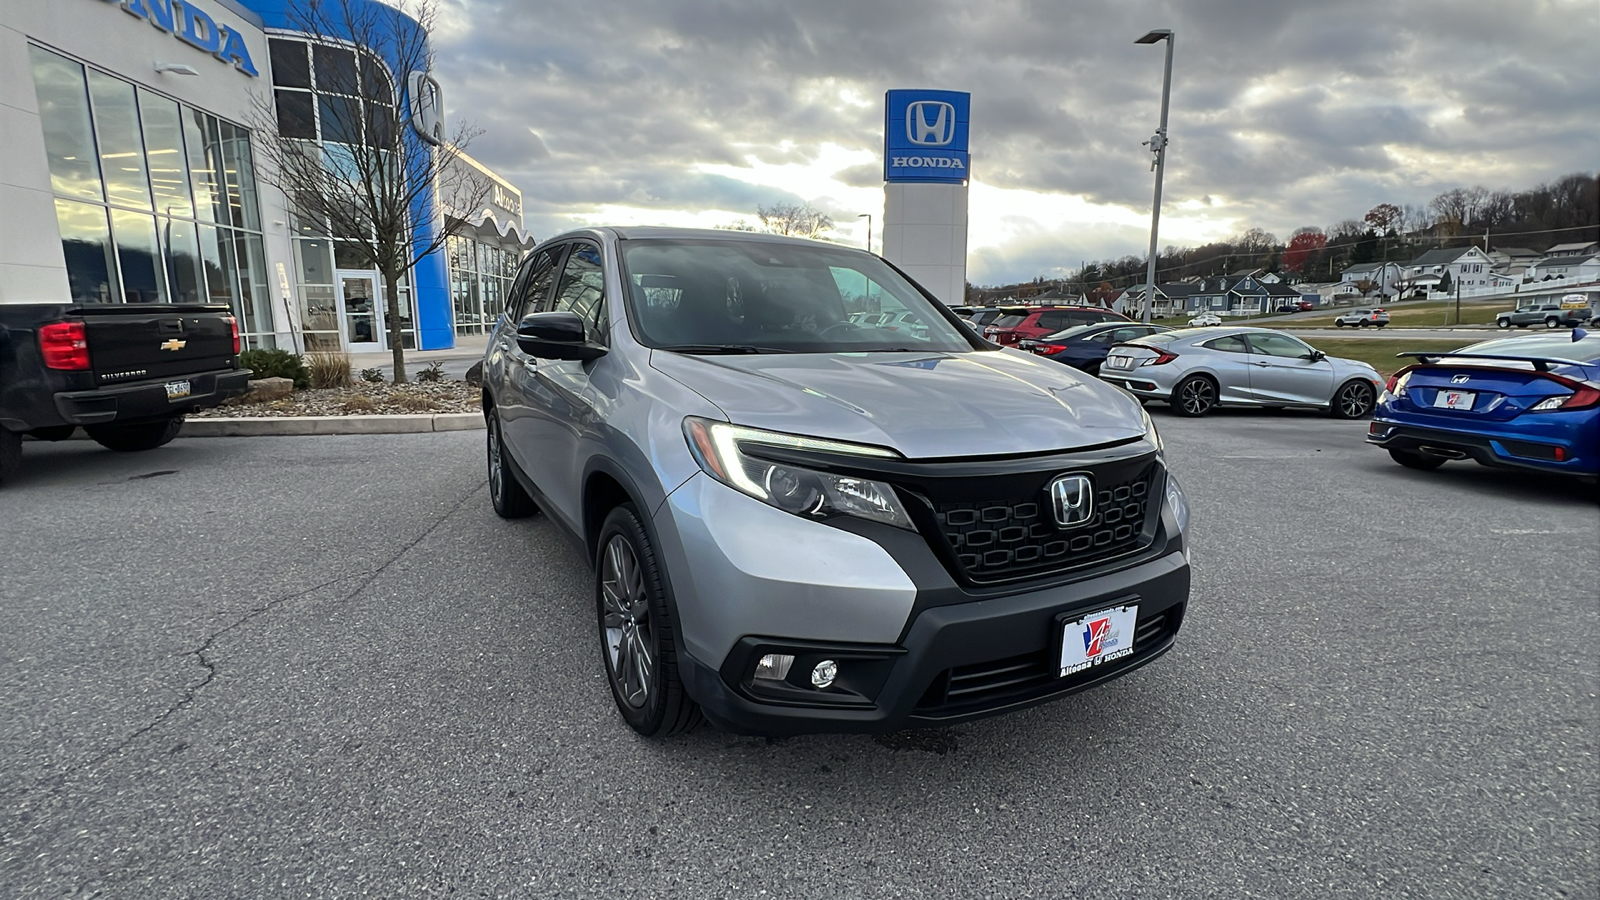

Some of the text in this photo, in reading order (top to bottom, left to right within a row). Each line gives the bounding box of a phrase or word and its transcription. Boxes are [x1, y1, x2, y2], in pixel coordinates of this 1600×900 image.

[112, 0, 259, 77] NDA
[892, 156, 965, 169] HONDA
[1060, 647, 1134, 677] Altoona HONDA
